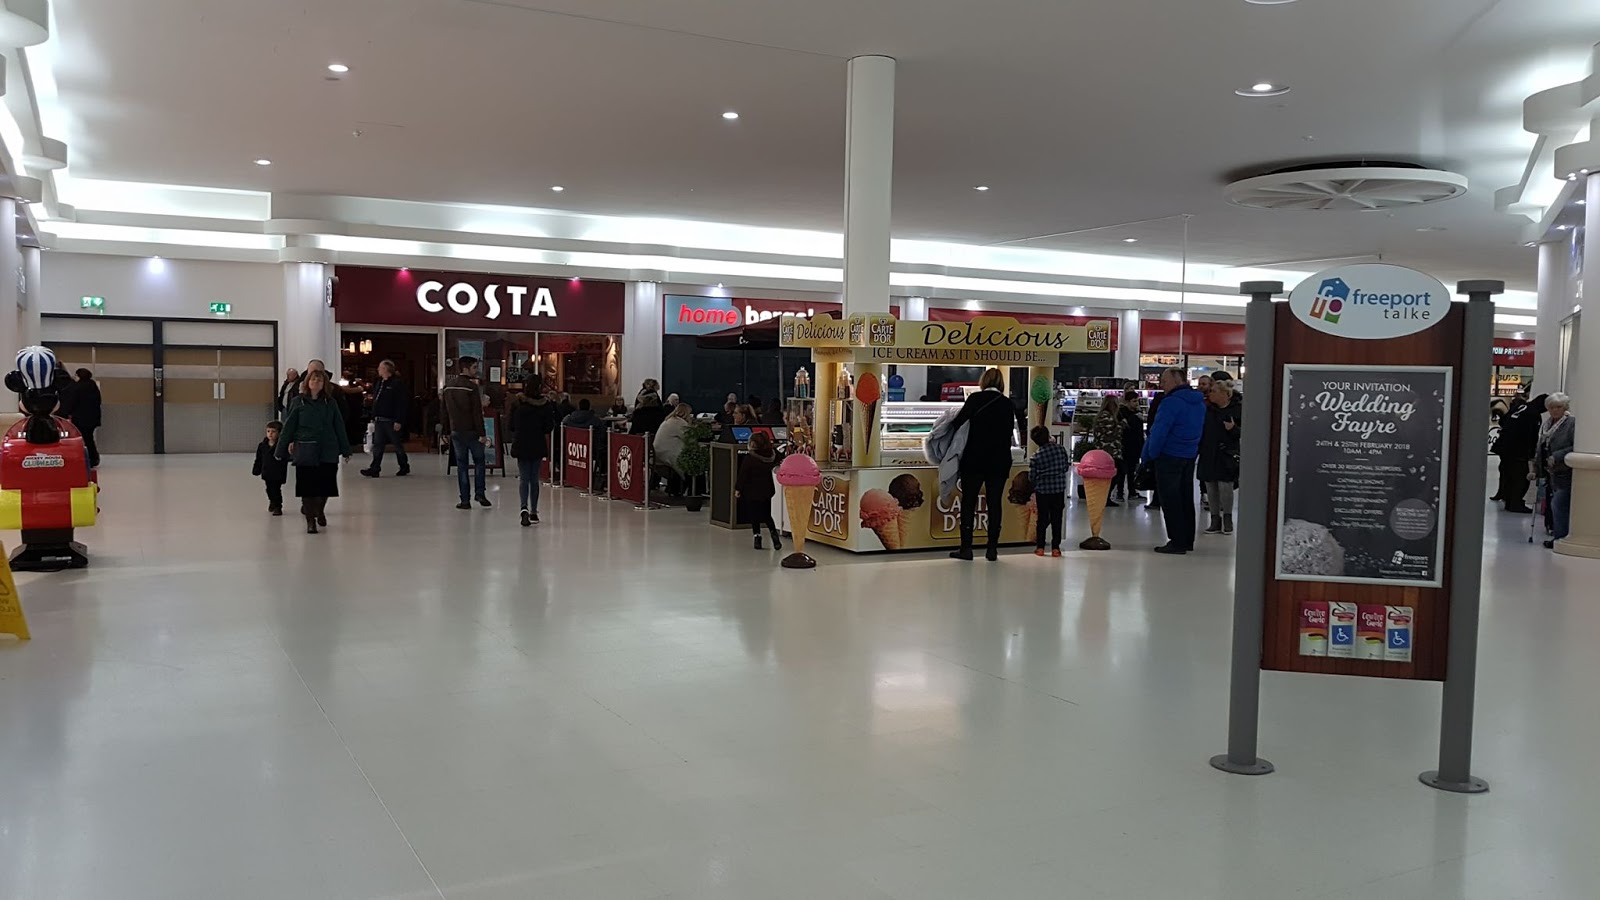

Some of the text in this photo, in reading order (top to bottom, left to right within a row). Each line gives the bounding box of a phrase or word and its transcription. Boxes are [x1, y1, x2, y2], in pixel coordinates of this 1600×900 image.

[416, 280, 558, 320] COSTA
[1353, 289, 1431, 309] freeport
[679, 304, 738, 325] home
[1384, 308, 1431, 320] talke
[797, 321, 847, 340] Delicious
[871, 323, 894, 334] CARTE
[873, 333, 892, 343] D'OR
[922, 322, 1070, 349] Delicious
[1088, 330, 1108, 340] CARTE
[1090, 339, 1106, 349] D'OR
[872, 347, 892, 358] ICE
[896, 348, 938, 360] CREAM
[941, 348, 955, 360] AS
[958, 349, 971, 360] IT
[974, 350, 1022, 362] SHOULD
[1322, 381, 1411, 392] YOUR INVITATION
[1315, 392, 1416, 421] Wedding
[1331, 412, 1397, 439] Fayre
[568, 442, 587, 459] COSTA
[812, 487, 846, 513] CARTE
[814, 509, 843, 535] D'OR
